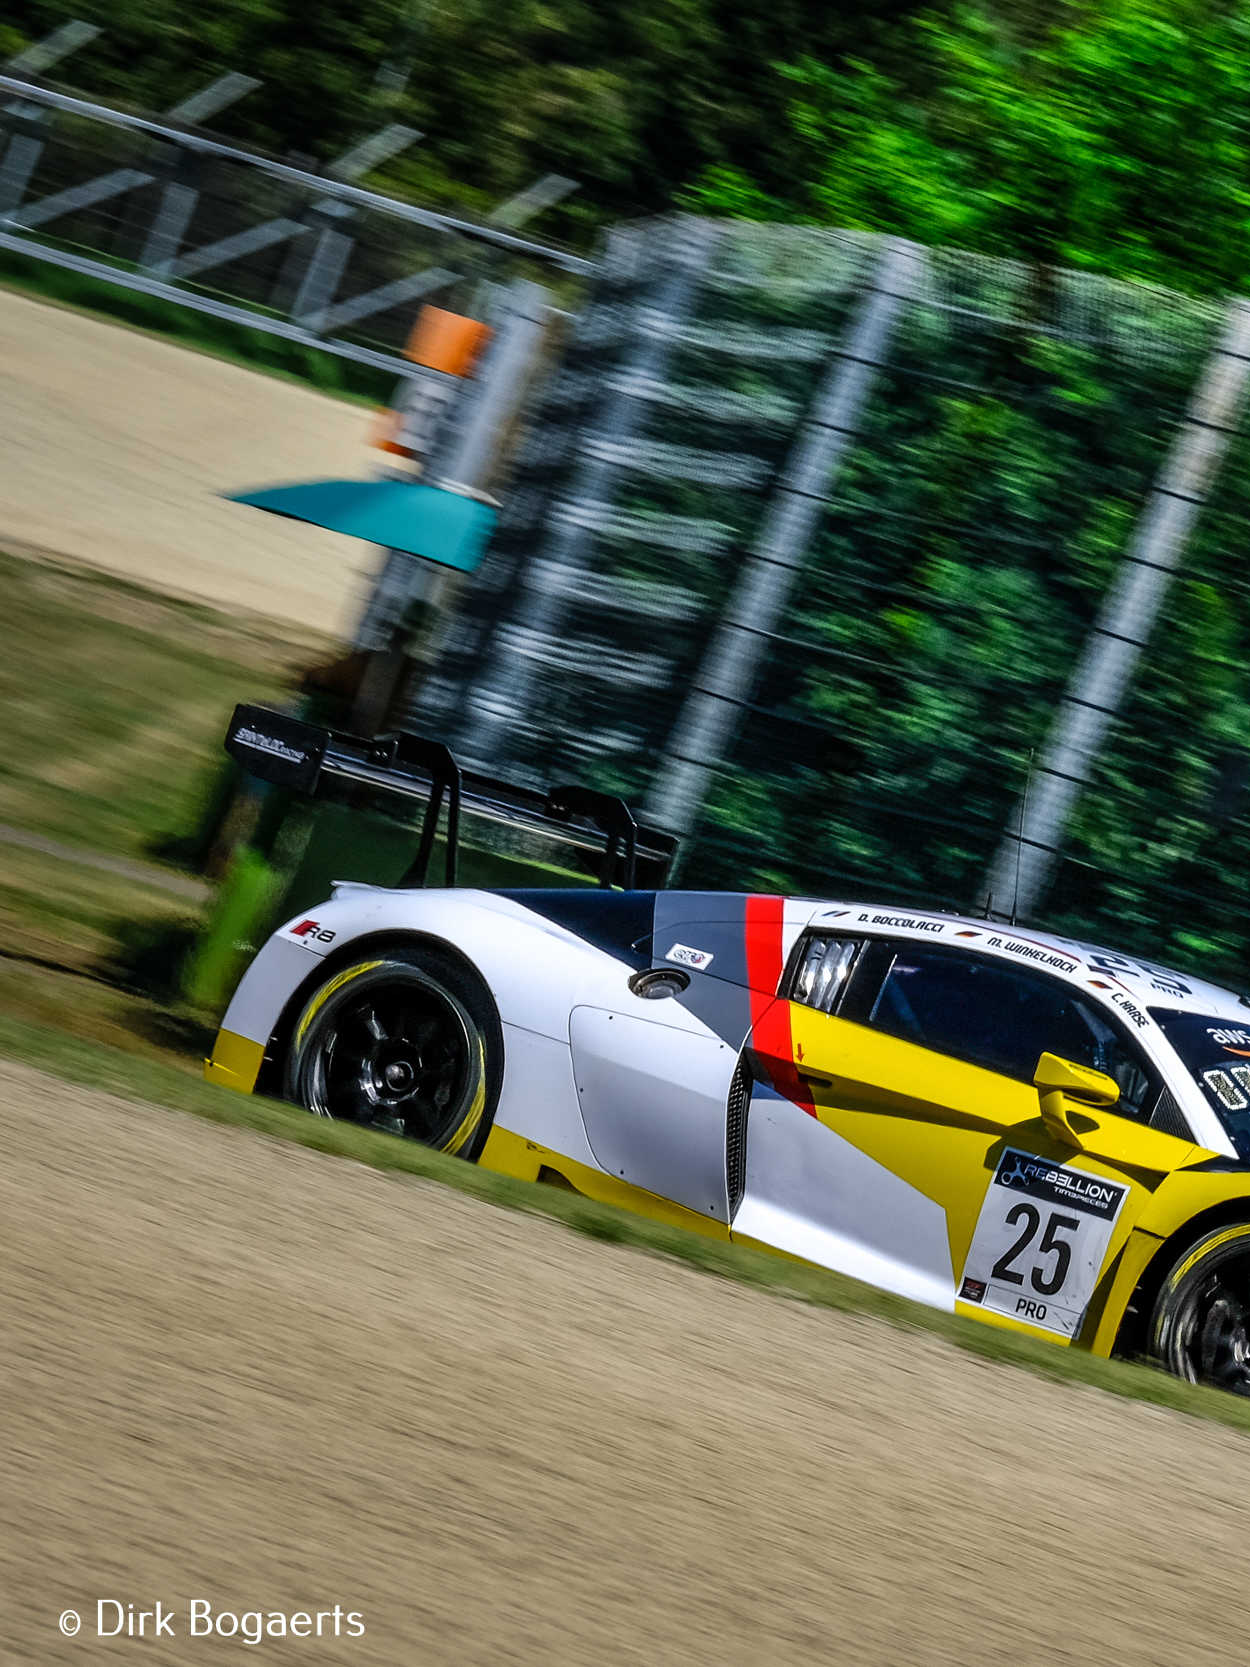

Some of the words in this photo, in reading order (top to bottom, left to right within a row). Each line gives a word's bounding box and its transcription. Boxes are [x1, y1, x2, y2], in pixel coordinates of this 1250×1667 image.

[858, 913, 869, 923] D.
[872, 915, 945, 933] BOCCOLACCI
[987, 936, 1002, 948] M.
[1004, 941, 1078, 974] WINKELHOCK
[1024, 1163, 1114, 1203] REBELLION
[991, 1202, 1081, 1296] 25
[1015, 1298, 1048, 1320] PRO
